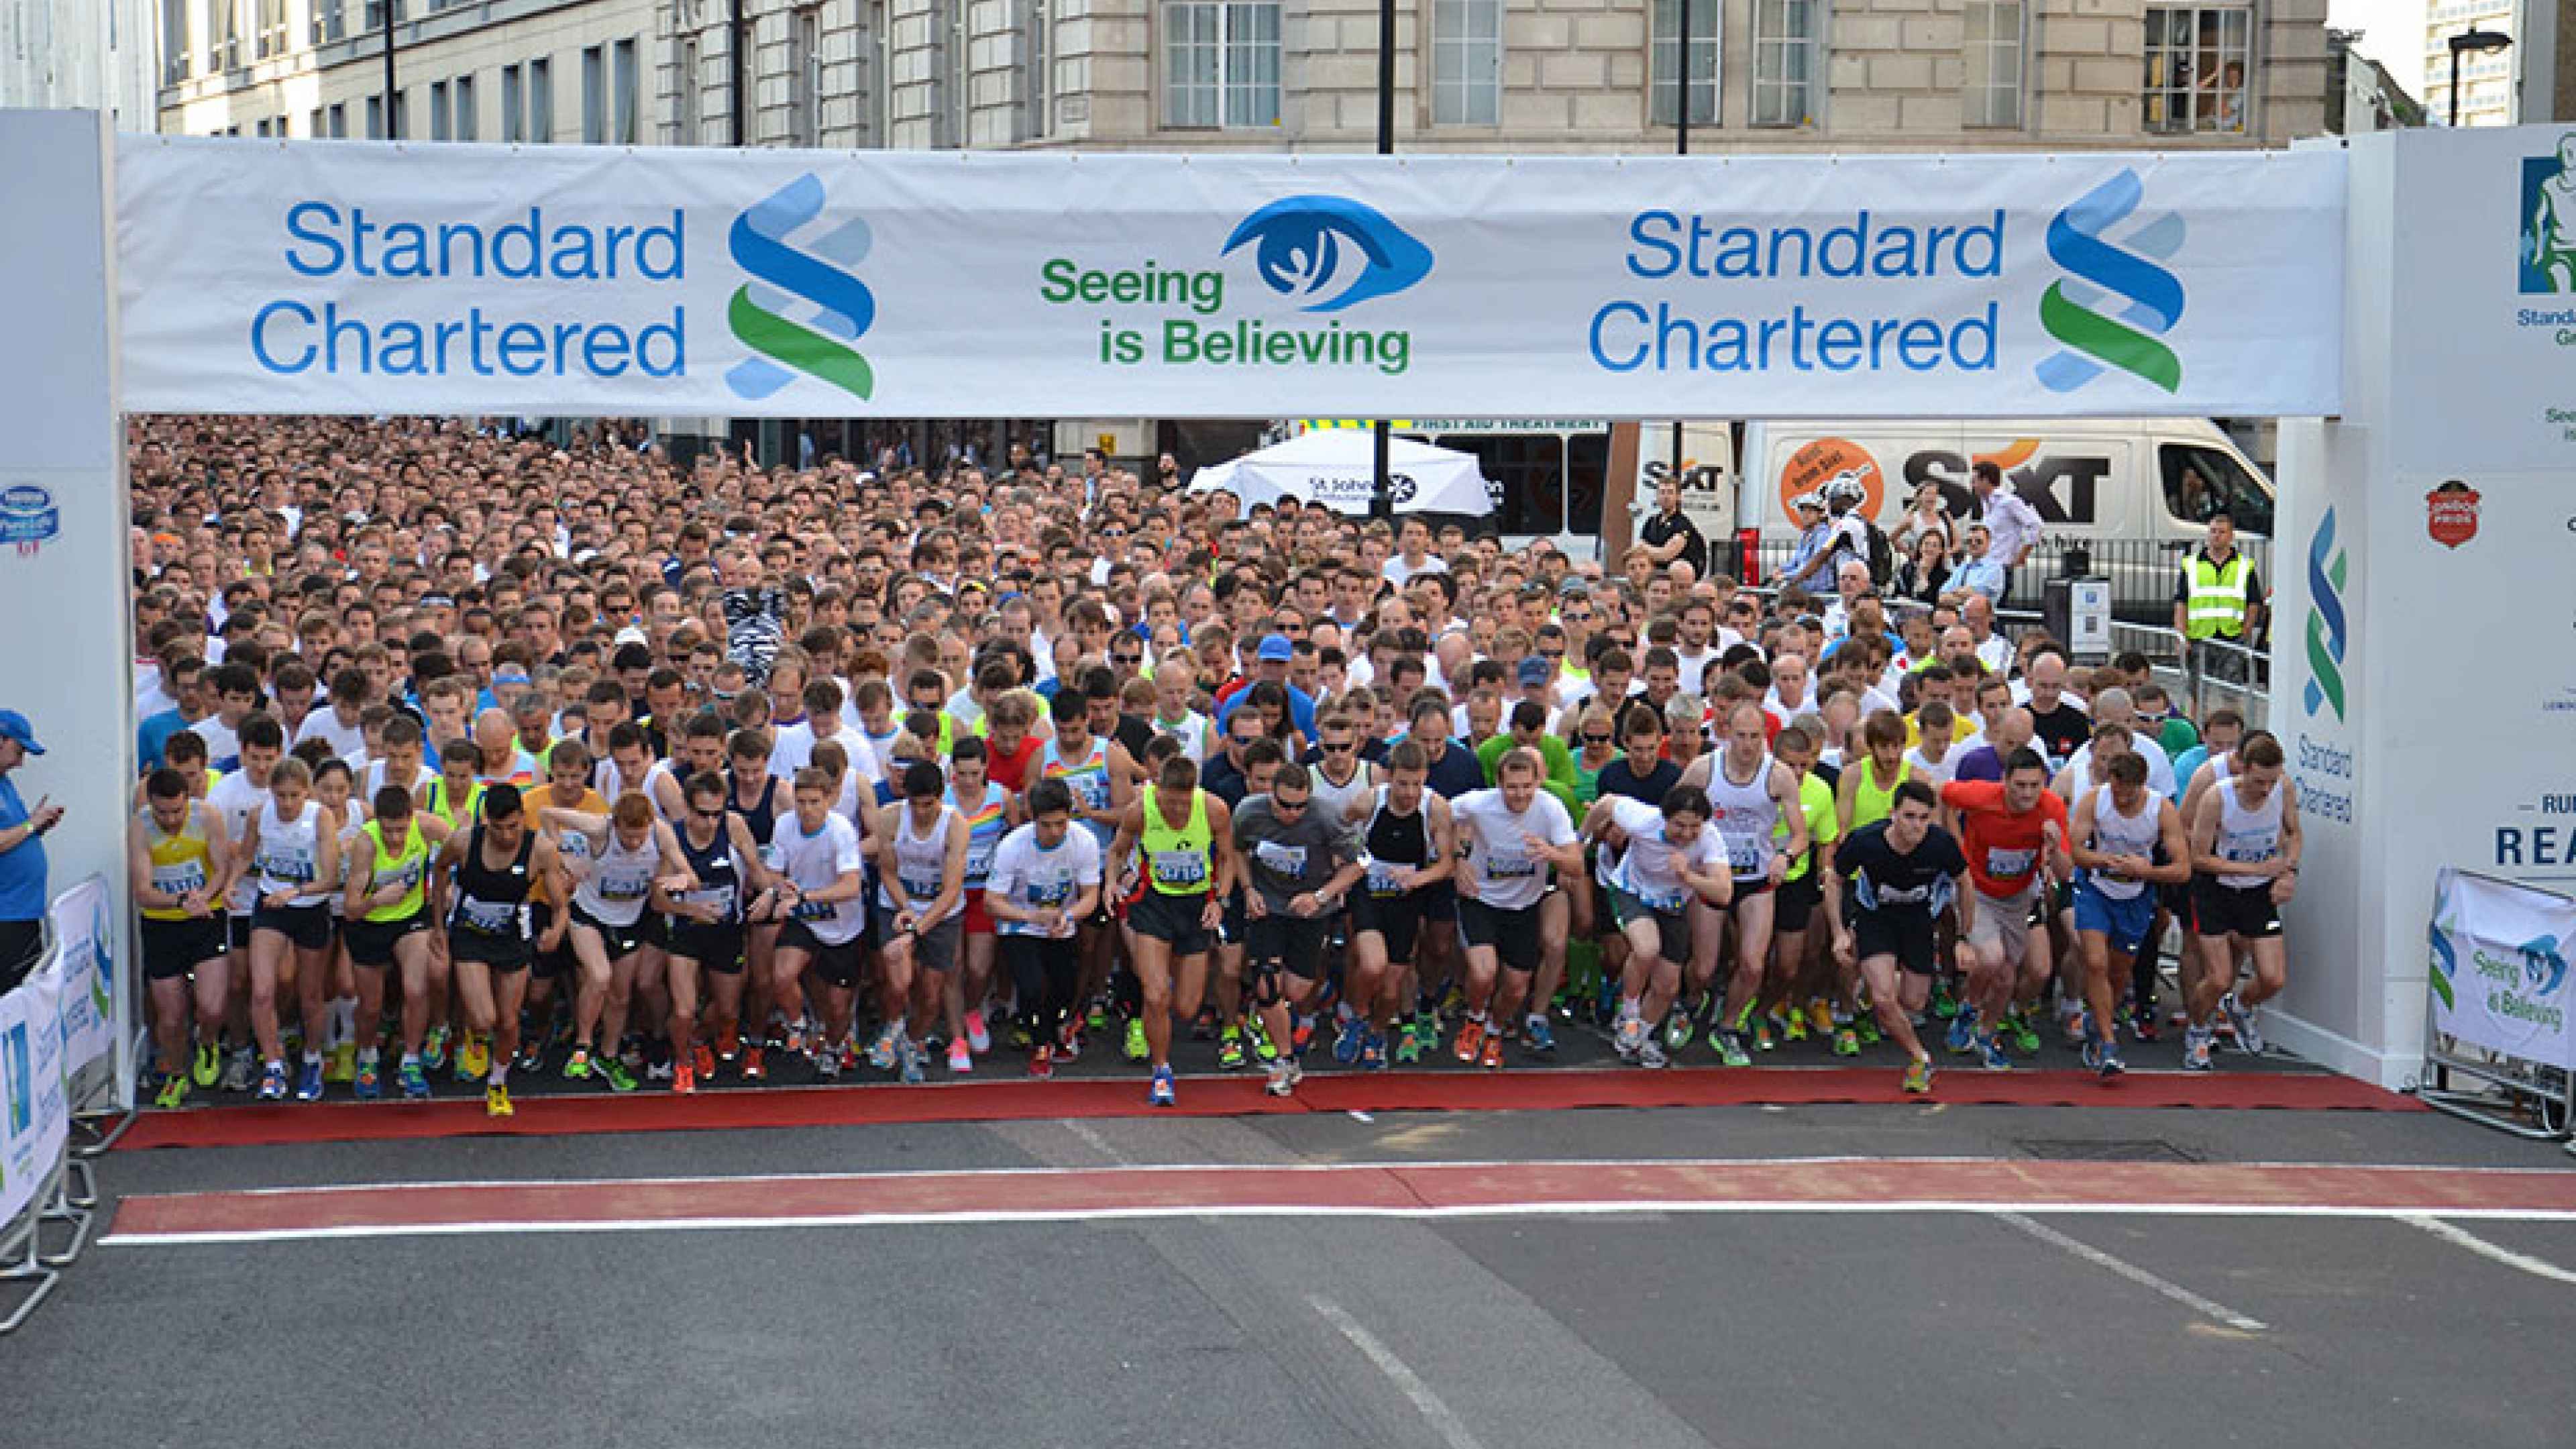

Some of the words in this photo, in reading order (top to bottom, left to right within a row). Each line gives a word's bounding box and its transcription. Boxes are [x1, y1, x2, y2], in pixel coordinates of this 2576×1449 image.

[284, 201, 686, 280] Standard
[1626, 209, 2006, 279] Standard
[1041, 258, 1224, 315] Seeing
[251, 300, 686, 378] Chartered
[1100, 319, 1143, 364] is
[1163, 319, 1409, 376] Believing
[1589, 300, 1998, 373] Chartered
[1642, 458, 1723, 492] SXT
[2298, 732, 2352, 781] Standard
[2542, 794, 2576, 814] RU
[2473, 950, 2519, 991] Seeing
[2502, 989, 2563, 1034] Believing
